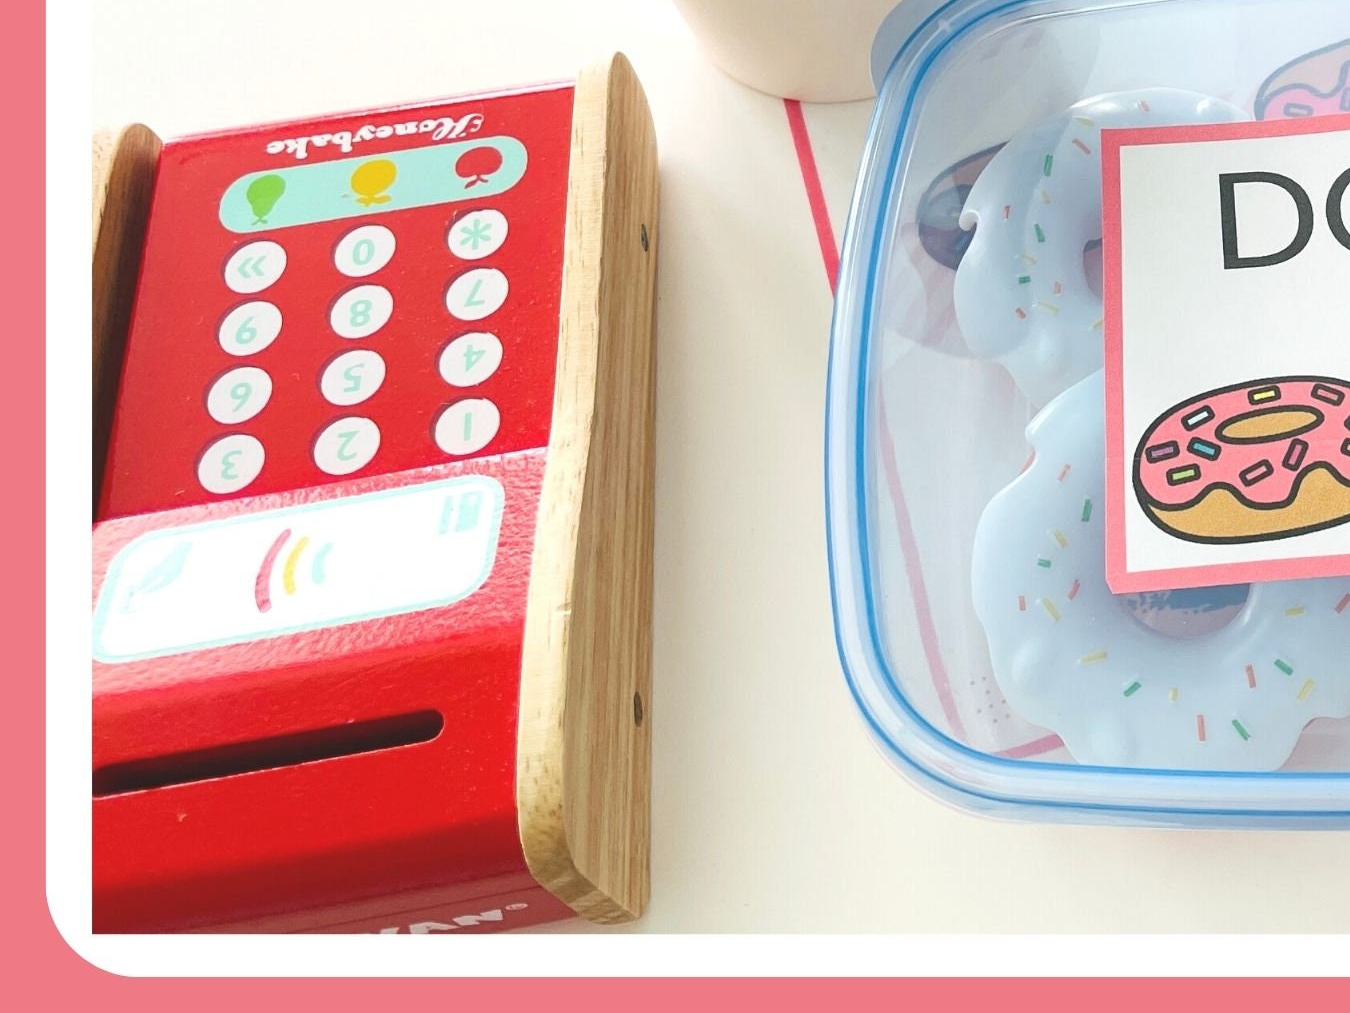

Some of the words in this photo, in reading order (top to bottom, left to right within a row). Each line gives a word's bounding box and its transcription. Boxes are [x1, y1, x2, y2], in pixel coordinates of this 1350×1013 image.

[265, 112, 485, 160] Honeybake
[351, 238, 375, 266] 0
[463, 280, 485, 308] 7
[348, 298, 372, 328] 8
[234, 315, 258, 346] 9
[461, 344, 486, 370] 4
[342, 364, 363, 394] 5
[229, 382, 253, 411] 6
[462, 411, 473, 442] 1
[336, 429, 360, 463] 2
[219, 451, 240, 480] 3
